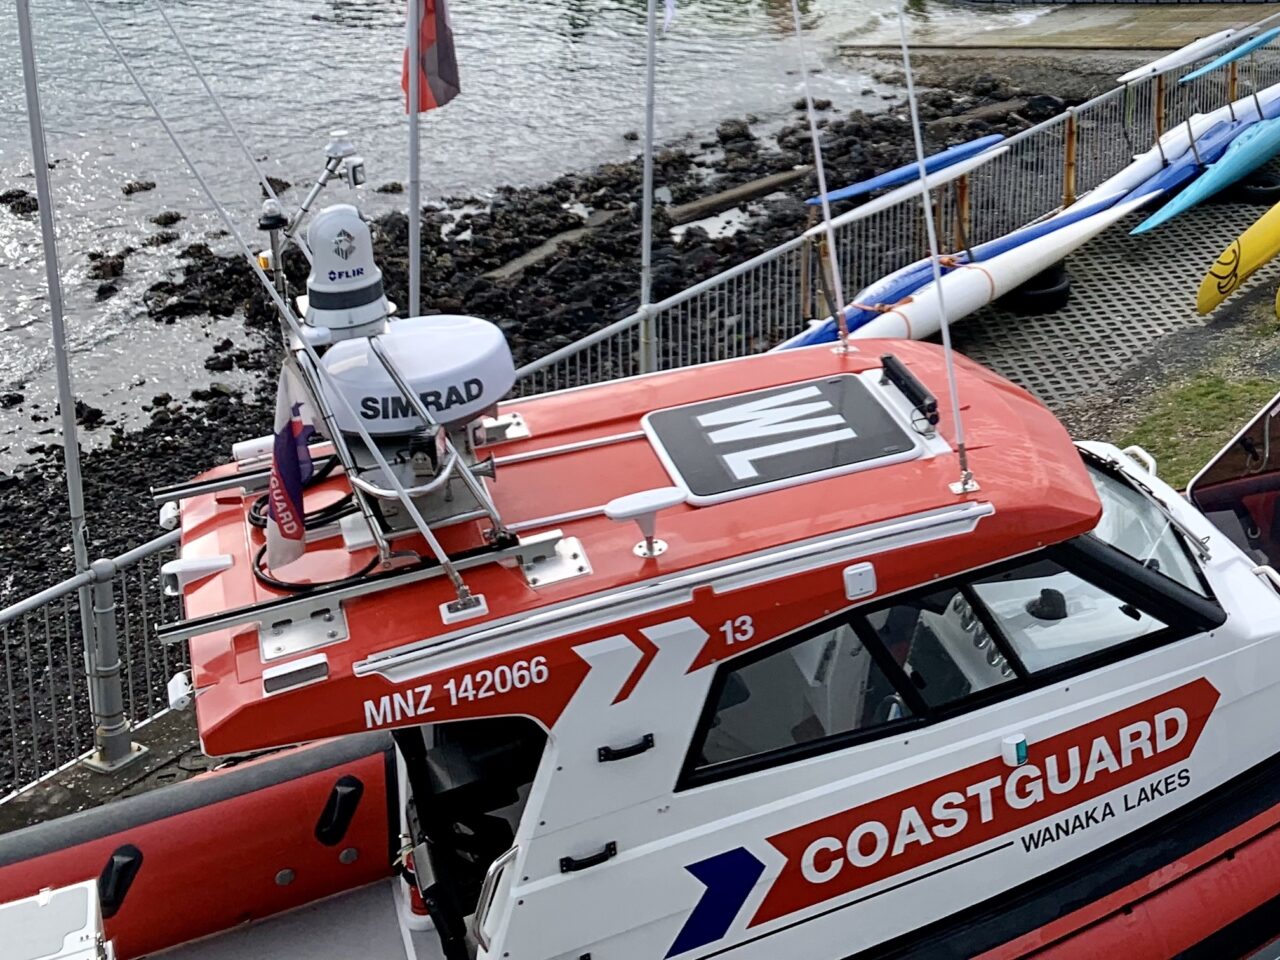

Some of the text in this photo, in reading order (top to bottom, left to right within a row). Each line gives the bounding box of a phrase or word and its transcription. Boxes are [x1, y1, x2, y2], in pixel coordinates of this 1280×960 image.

[338, 267, 364, 280] FLIR
[360, 377, 484, 420] SIMRAD
[719, 615, 755, 646] 13
[363, 656, 549, 728] MNZ 142066
[800, 707, 1190, 884] COASTGUARD
[1020, 768, 1191, 853] WANAKA LAKES
